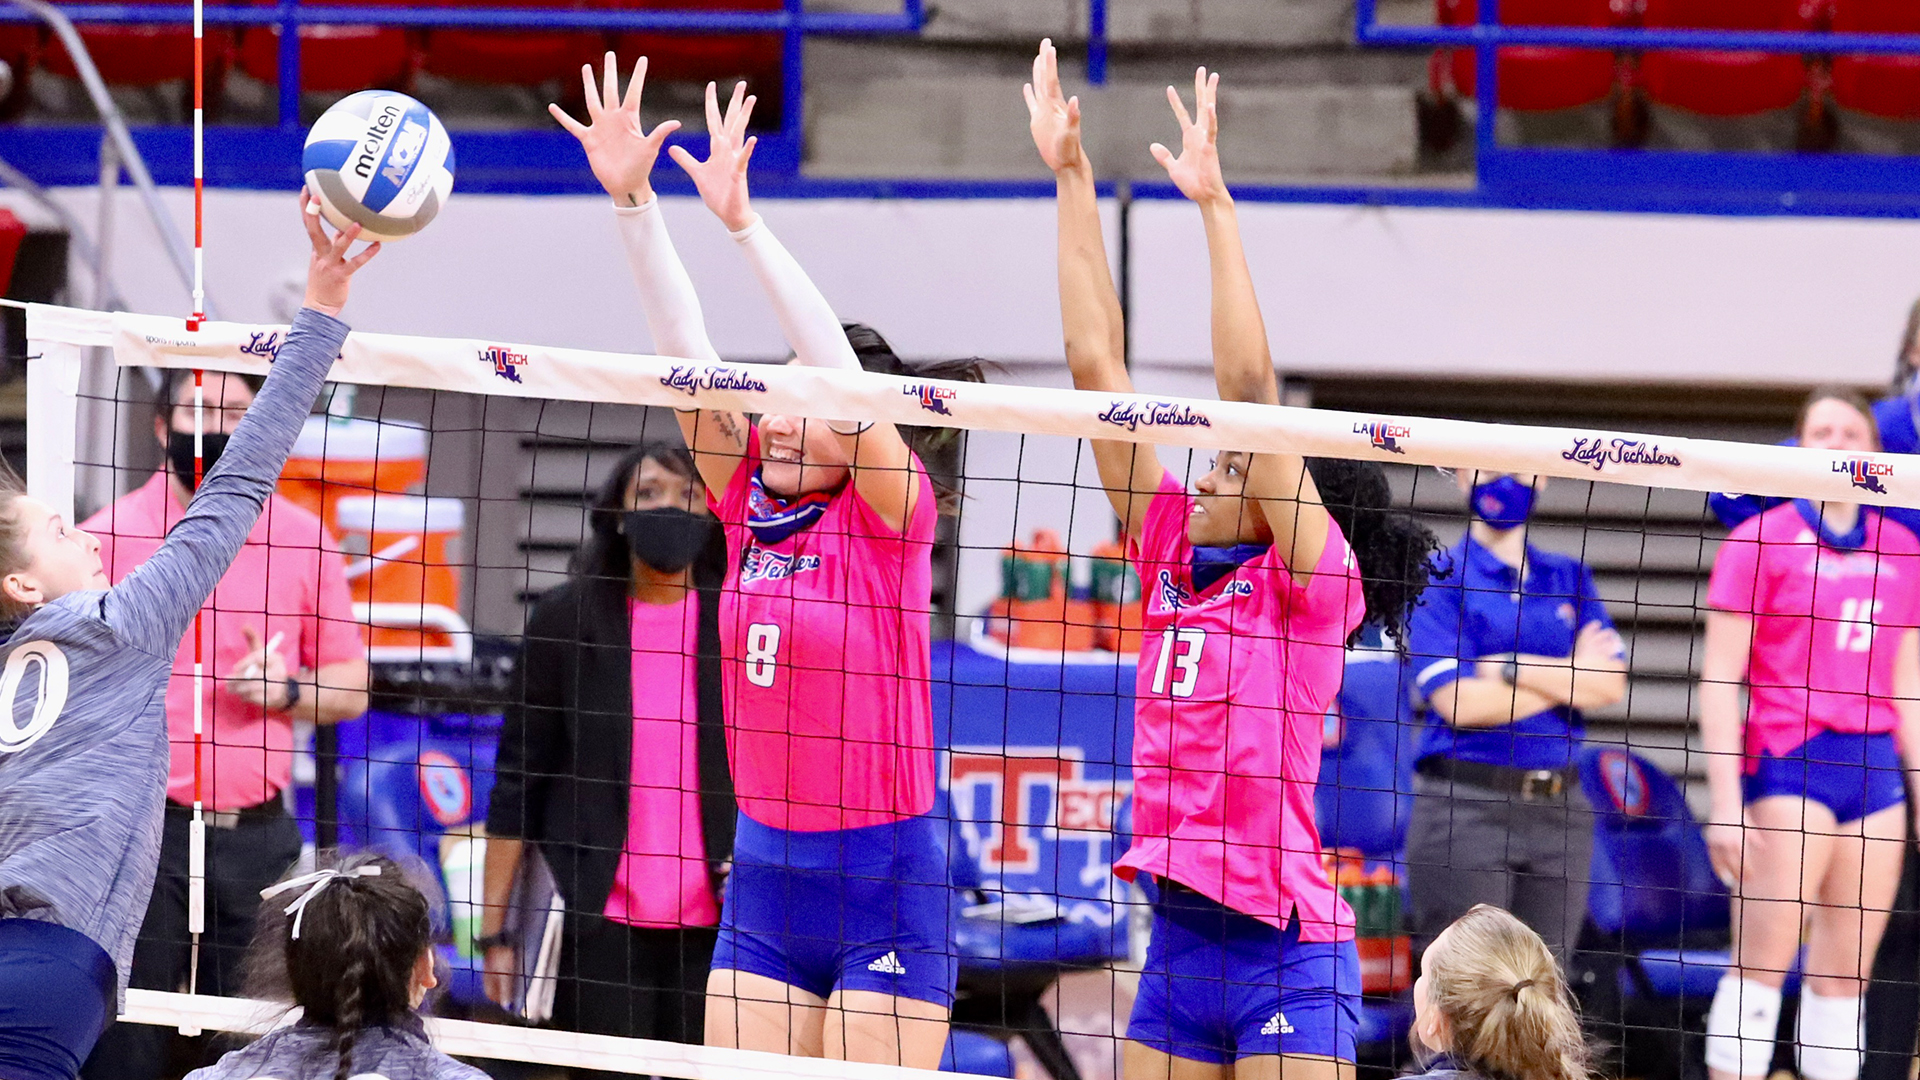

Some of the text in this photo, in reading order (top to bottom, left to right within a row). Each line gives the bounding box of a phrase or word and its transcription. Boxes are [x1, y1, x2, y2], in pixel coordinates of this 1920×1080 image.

[355, 105, 400, 179] molten
[240, 331, 280, 363] Lady
[660, 365, 767, 395] Lady Techsters
[1098, 401, 1211, 431] Lady Techsters
[1562, 437, 1681, 471] Lady Techsters
[1836, 598, 1883, 652] 15
[745, 622, 781, 688] 8
[1151, 625, 1207, 698] 13
[0, 640, 69, 752] 0
[867, 963, 906, 975] adidas
[1260, 1025, 1295, 1035] adidas
